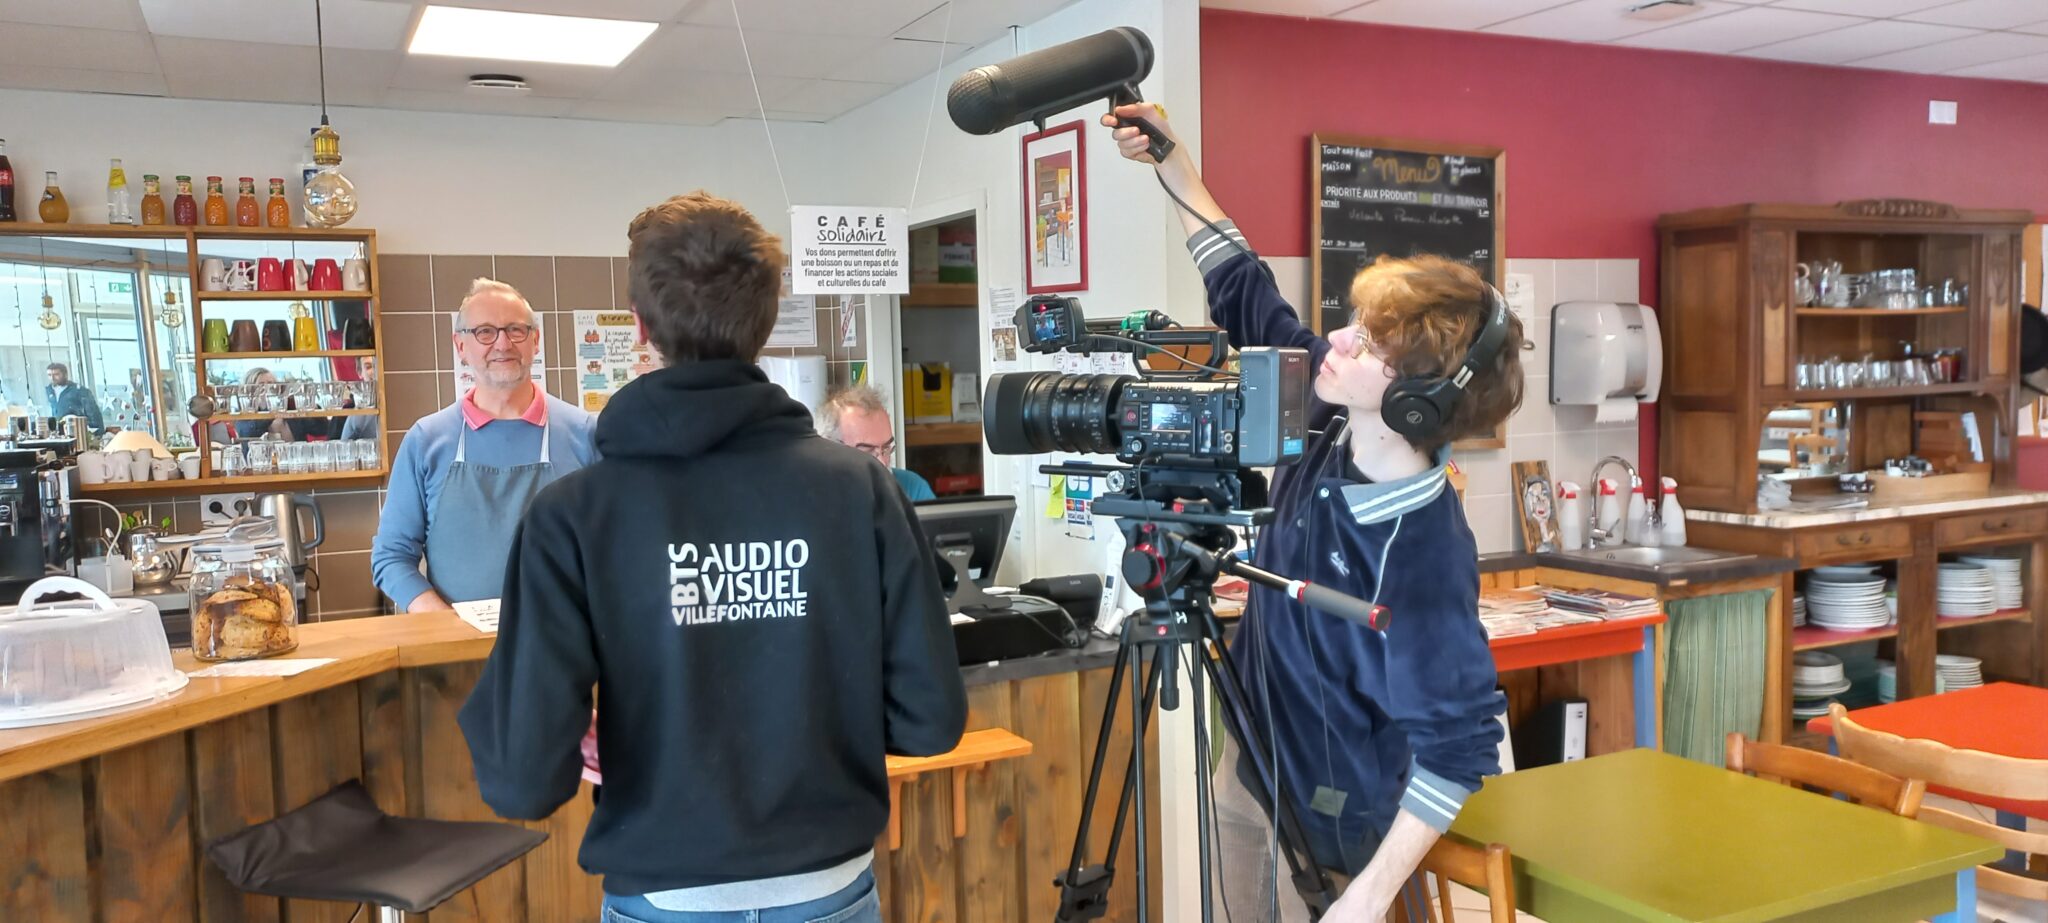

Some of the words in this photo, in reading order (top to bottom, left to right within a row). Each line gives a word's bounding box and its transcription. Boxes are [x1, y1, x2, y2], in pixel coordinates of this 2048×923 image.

[1373, 156, 1440, 184] Menu
[1363, 189, 1378, 198] AUX
[1380, 189, 1417, 202] PRODUITS
[817, 214, 885, 228] CAFÉ
[817, 227, 887, 243] solidaire
[805, 248, 818, 257] Vos
[819, 248, 836, 257] dons
[837, 249, 874, 258] permettent
[816, 259, 842, 267] boisson
[863, 260, 882, 268] repas
[882, 259, 890, 267] et
[890, 259, 899, 267] de
[804, 268, 834, 277] financer
[835, 268, 845, 277] les
[846, 268, 870, 277] actions
[871, 268, 898, 277] sociales
[817, 278, 825, 287] et
[826, 278, 861, 287] culturelles
[862, 278, 871, 287] du
[871, 278, 887, 287] café
[701, 539, 809, 573] AUDIO
[668, 543, 699, 606] BTS
[700, 569, 808, 604] VISUEL
[672, 600, 807, 626] VILLEFONTAINE
